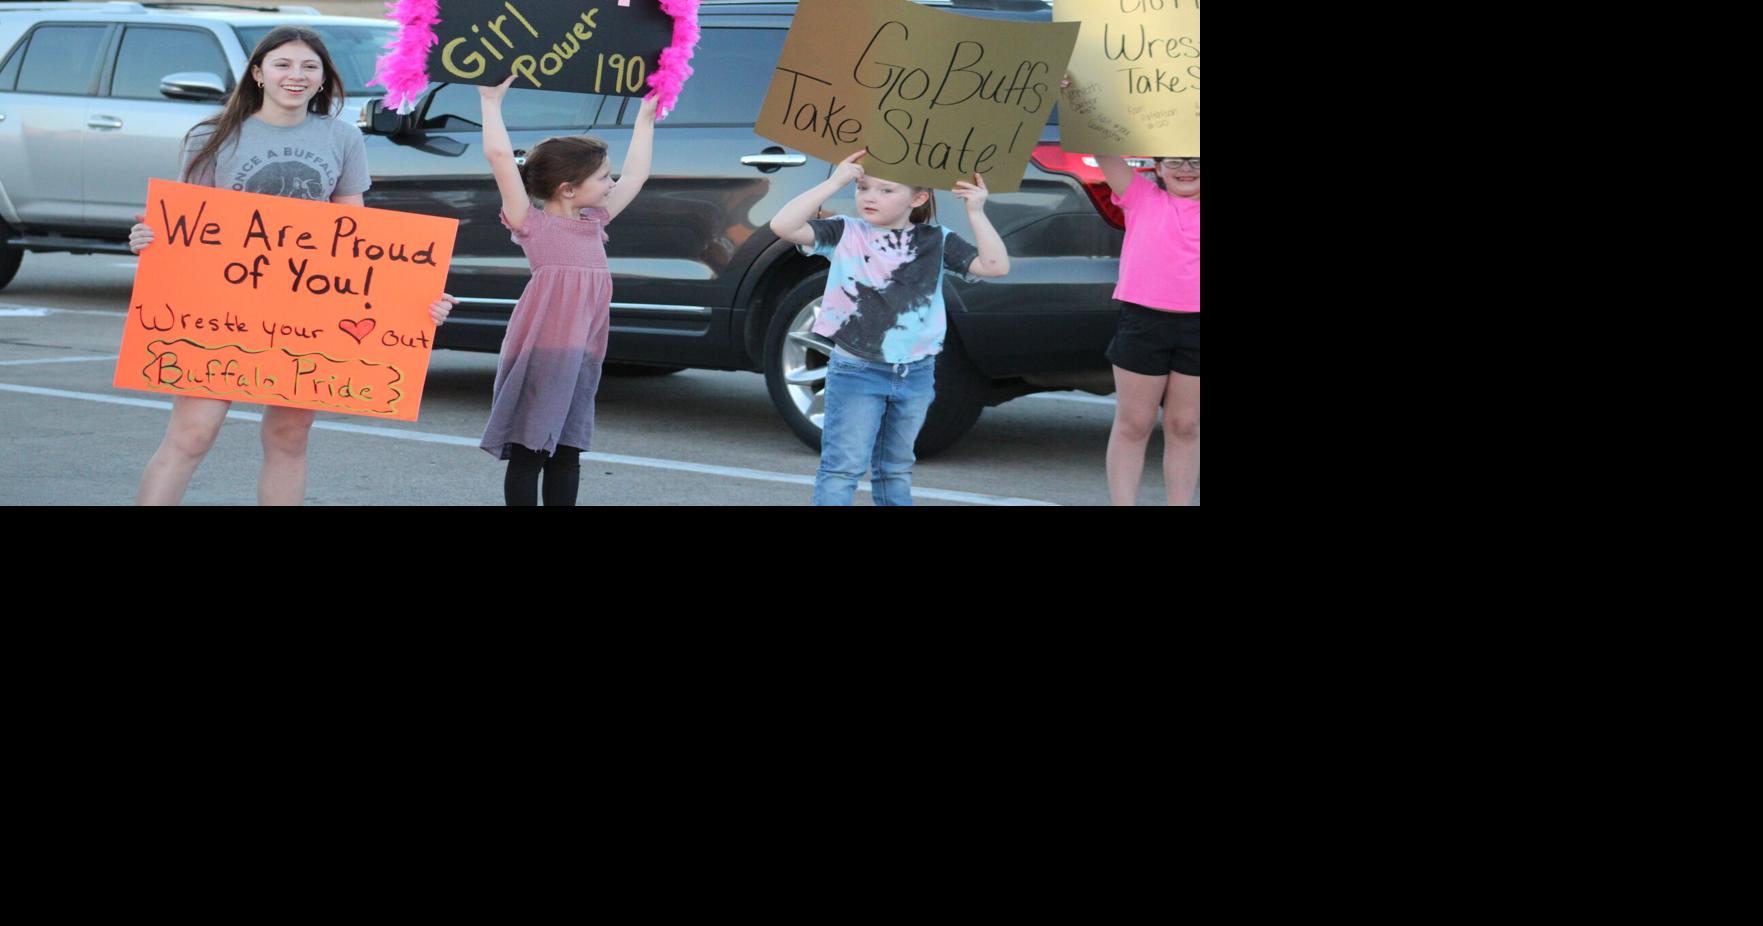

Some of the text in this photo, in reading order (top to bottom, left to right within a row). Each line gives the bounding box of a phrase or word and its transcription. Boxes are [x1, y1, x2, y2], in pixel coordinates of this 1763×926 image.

[442, 1, 538, 79] Girl
[510, 8, 599, 88] Power
[853, 20, 1049, 114] Go Buffs
[594, 53, 646, 93] 190
[776, 66, 1024, 174] Take State!
[232, 147, 336, 191] ONCE A BUFFALO
[160, 199, 437, 267] We Are Proud
[224, 254, 374, 310] of You!
[262, 320, 324, 348] your
[381, 330, 430, 348] out
[157, 352, 374, 400] Buffalo Pride
